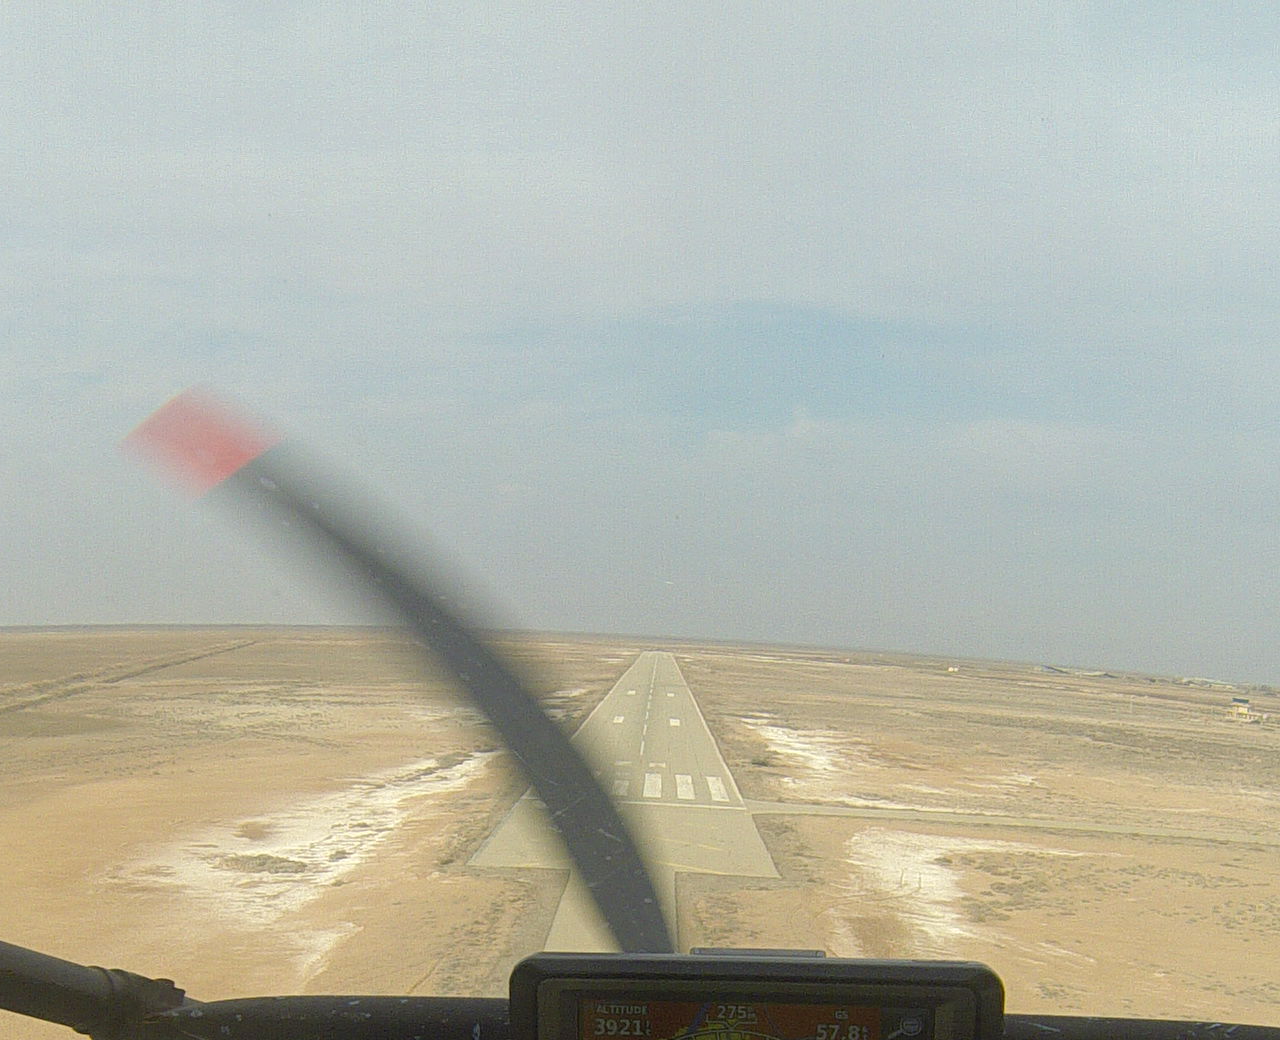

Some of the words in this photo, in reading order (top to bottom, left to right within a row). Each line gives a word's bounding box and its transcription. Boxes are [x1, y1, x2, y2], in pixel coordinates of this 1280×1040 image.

[597, 1006, 648, 1015] ALTITUDE
[594, 1018, 644, 1036] 3921
[816, 1024, 860, 1040] 57.8
